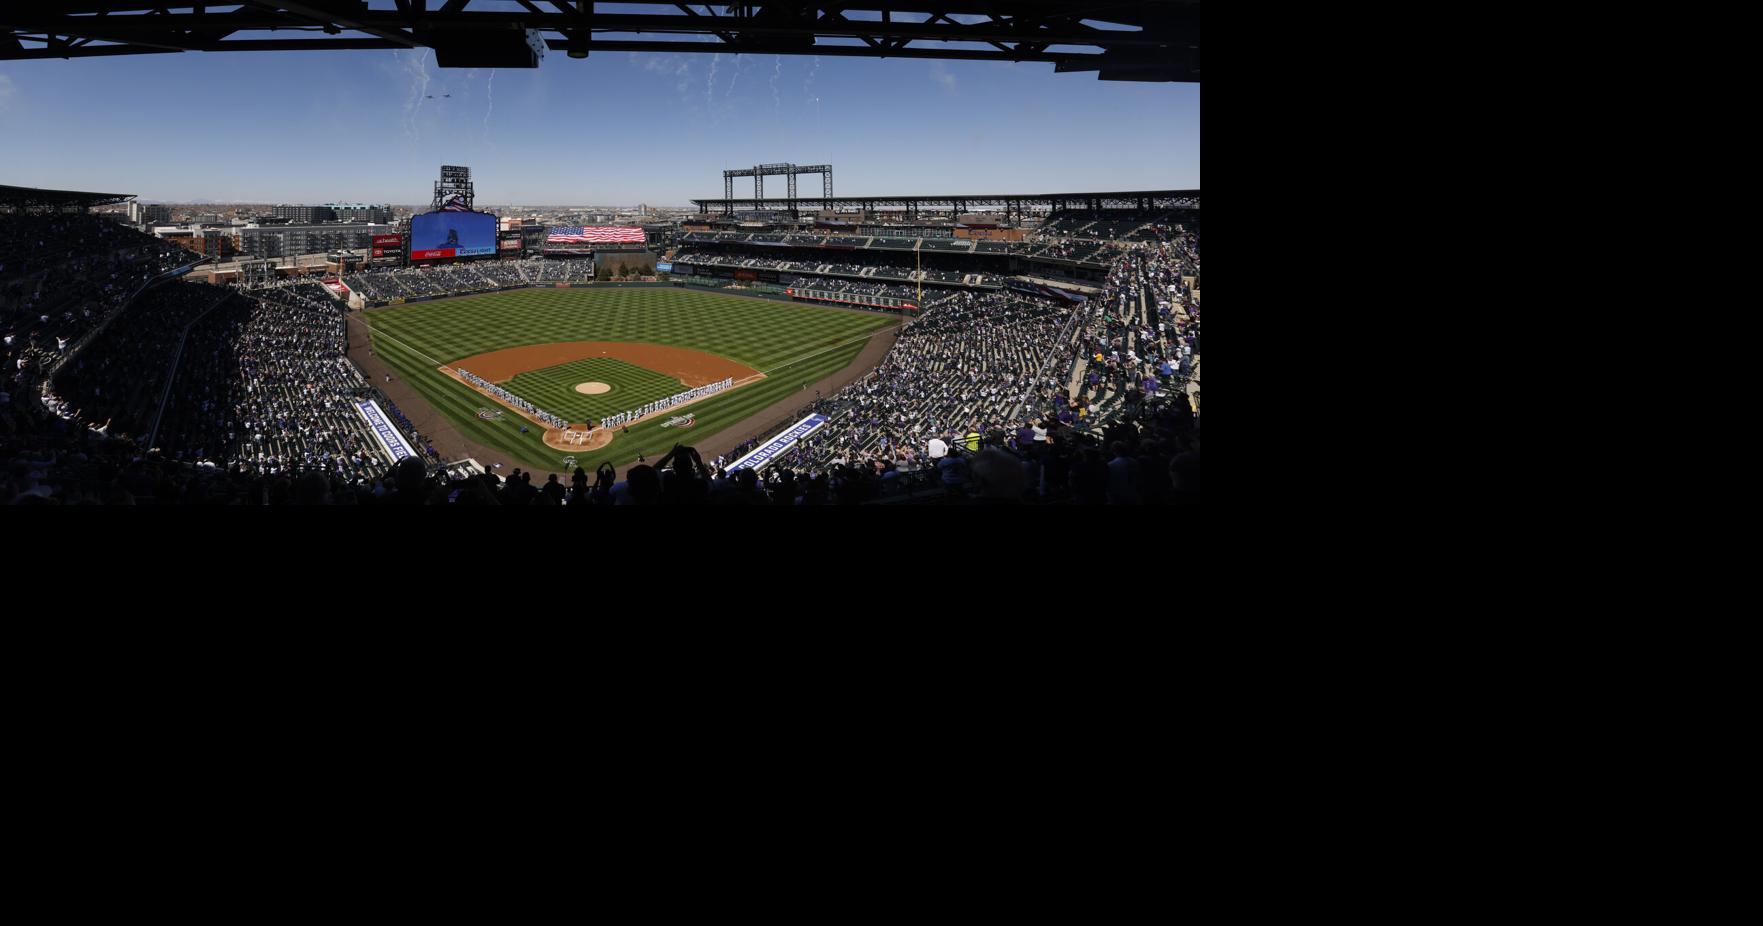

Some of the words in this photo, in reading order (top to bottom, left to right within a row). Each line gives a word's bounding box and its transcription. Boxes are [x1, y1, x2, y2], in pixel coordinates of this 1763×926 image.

[364, 405, 384, 425] WELCOME
[381, 430, 400, 447] COORS
[780, 423, 811, 444] ROCKIES
